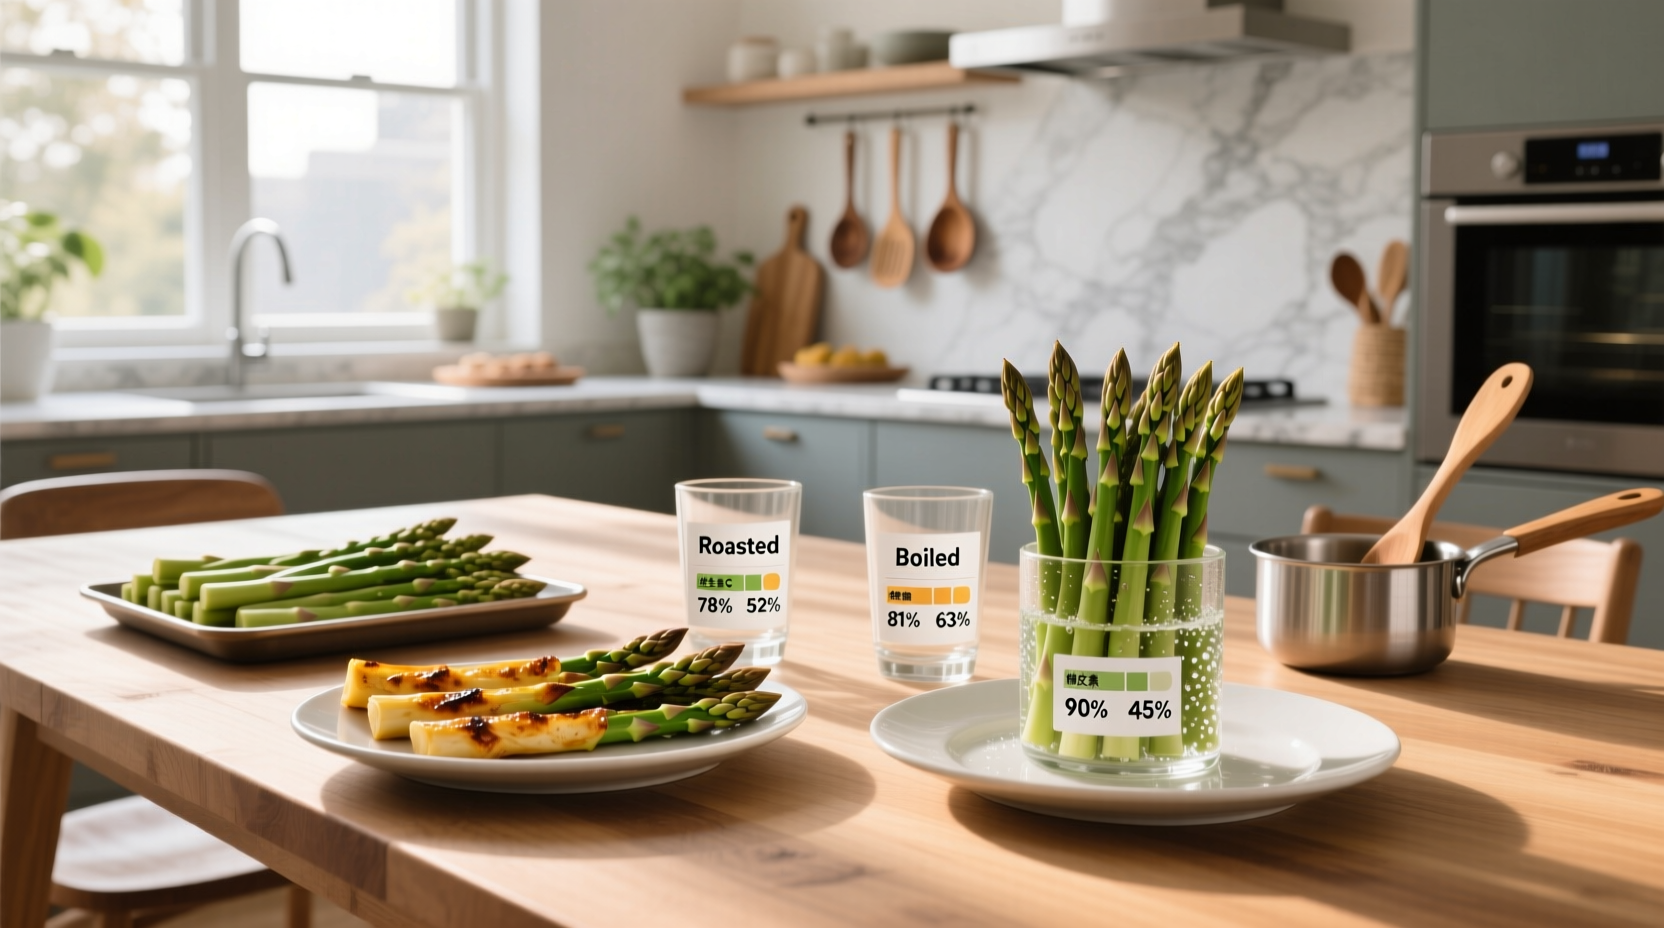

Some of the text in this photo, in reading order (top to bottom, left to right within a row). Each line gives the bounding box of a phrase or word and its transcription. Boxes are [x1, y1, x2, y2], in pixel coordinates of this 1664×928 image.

[698, 534, 779, 556] Roasted
[895, 546, 960, 568] Boiled
[697, 596, 781, 614] 78% 52%
[887, 610, 971, 629] 81% 63%
[1064, 697, 1172, 721] 90% 45%
